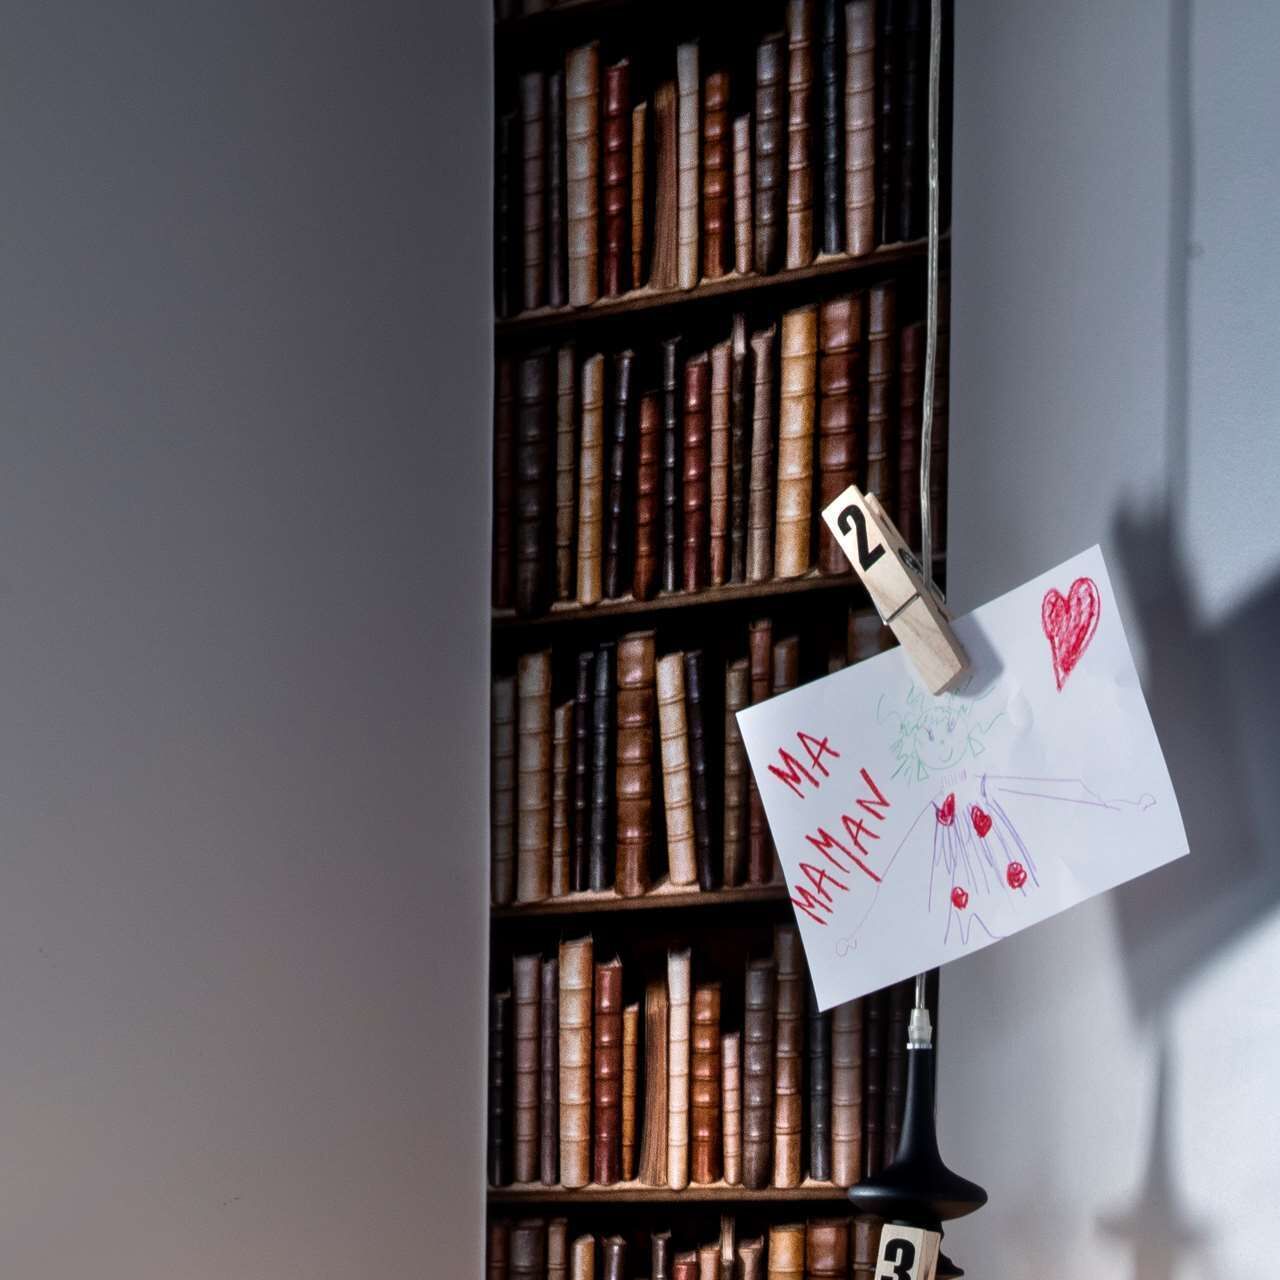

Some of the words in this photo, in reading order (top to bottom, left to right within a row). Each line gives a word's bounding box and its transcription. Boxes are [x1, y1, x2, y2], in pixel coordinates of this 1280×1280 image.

[838, 504, 886, 571] 2
[768, 731, 840, 799] MA
[790, 768, 891, 925] MAMAN
